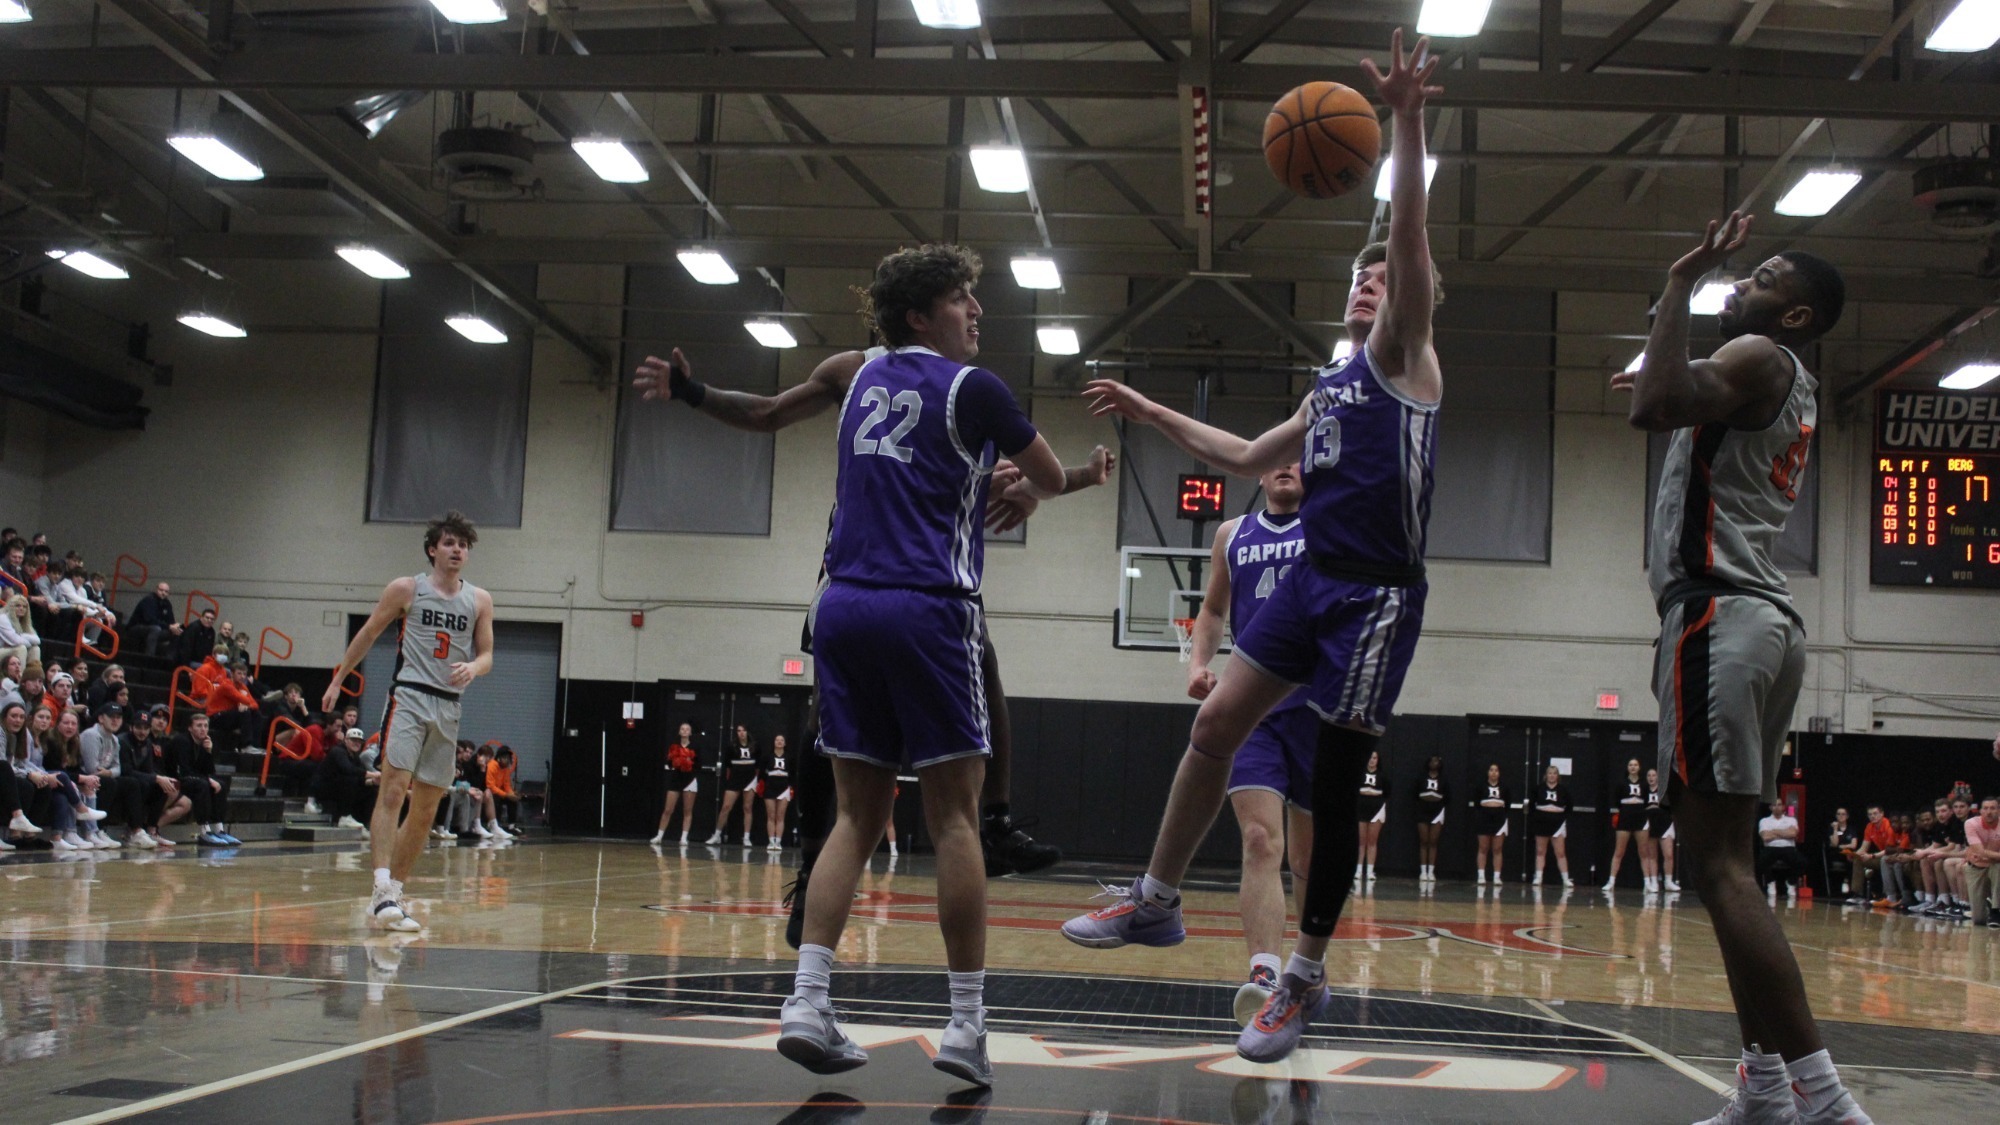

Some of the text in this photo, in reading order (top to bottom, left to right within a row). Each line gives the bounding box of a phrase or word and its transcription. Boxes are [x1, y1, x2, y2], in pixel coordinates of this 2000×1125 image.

[853, 386, 923, 463] 22
[1304, 415, 1342, 474] 13
[1880, 459, 1930, 472] PL PT F
[1948, 459, 1974, 471] BERG
[1884, 477, 1936, 489] 04 3 0
[1965, 476, 1988, 502] 17
[1182, 479, 1221, 511] 24
[1887, 490, 1936, 504] 11 5 0
[1884, 504, 1936, 517] 05 0 0
[1883, 518, 1936, 531] 03 4 0
[1883, 532, 1936, 546] 31 0 0
[1988, 544, 2000, 563] 6
[1255, 565, 1293, 600] 4
[421, 608, 468, 632] BERG
[433, 631, 450, 659] 3
